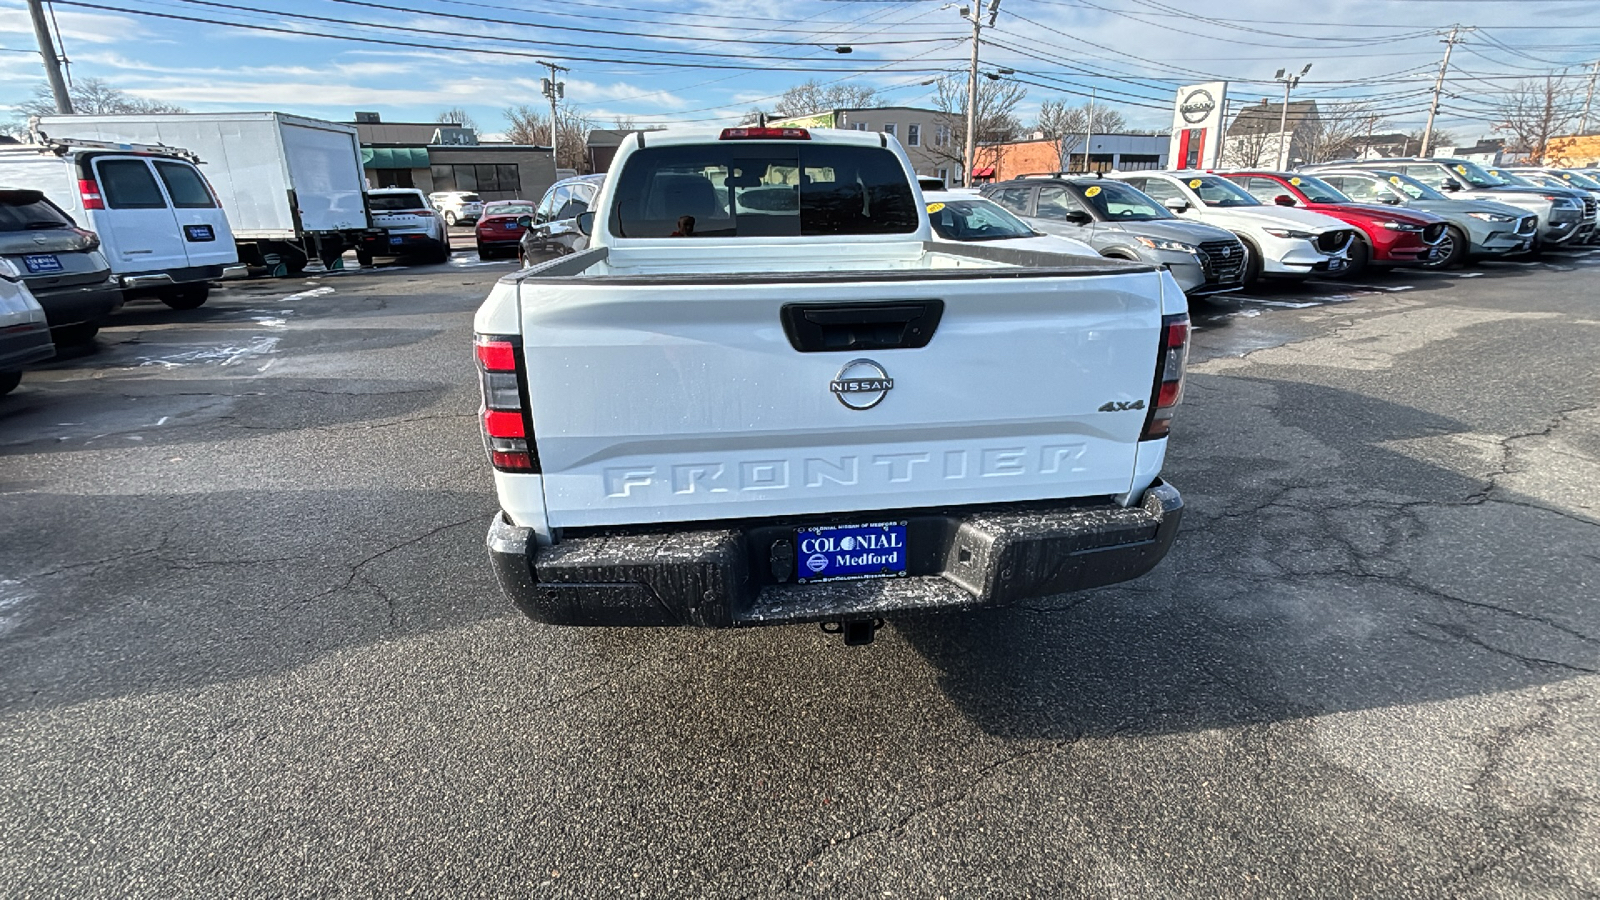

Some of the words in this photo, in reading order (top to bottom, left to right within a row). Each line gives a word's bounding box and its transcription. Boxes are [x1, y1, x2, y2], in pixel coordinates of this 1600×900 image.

[832, 380, 893, 392] NISSAN
[603, 442, 1088, 498] FRONTIER
[801, 533, 902, 554] COLONIAL
[835, 551, 898, 567] Medford
